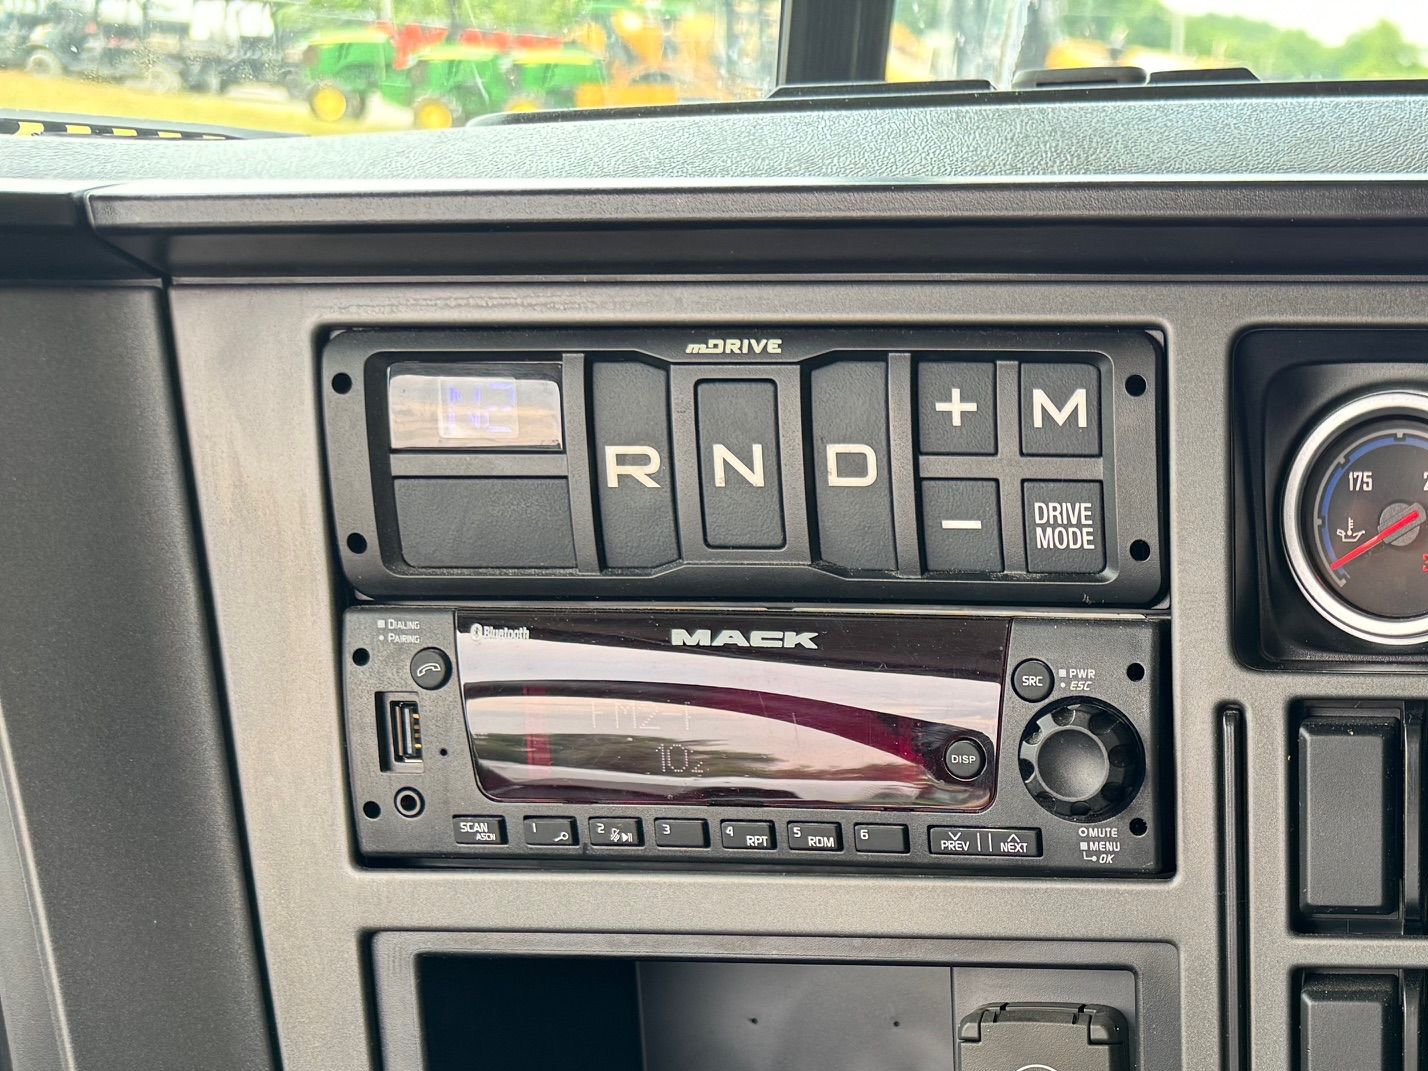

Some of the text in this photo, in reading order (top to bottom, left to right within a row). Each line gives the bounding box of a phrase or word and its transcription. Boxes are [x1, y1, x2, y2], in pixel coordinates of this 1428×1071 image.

[685, 339, 782, 354] mDRIVE
[1033, 389, 1086, 429] M
[606, 446, 660, 487] R
[715, 445, 764, 487] N
[826, 445, 876, 487] D
[1348, 472, 1373, 491] 175
[1034, 503, 1092, 525] DRIVE
[1036, 528, 1094, 550] MODE
[388, 620, 420, 630] DIALING
[388, 634, 420, 643] PAIRING
[483, 626, 530, 640] Bluetooth
[671, 628, 819, 648] MACK
[1069, 669, 1095, 678] PWR
[1022, 676, 1043, 687] SRC
[1070, 681, 1092, 690] ESC
[951, 755, 976, 764] DISP
[460, 822, 488, 832] SCAN
[532, 823, 536, 833] 1
[597, 823, 605, 834] 2
[663, 824, 671, 834] 3
[726, 827, 734, 836] 4
[1089, 828, 1119, 837] MUTE
[476, 833, 496, 841] ASCN
[793, 828, 801, 838] 5
[860, 830, 869, 840] 6
[746, 836, 768, 847] RPT
[808, 837, 835, 848] RDM
[941, 840, 970, 851] PREV
[1089, 842, 1121, 852] MENU
[1000, 842, 1028, 853] NEXT
[1099, 854, 1115, 863] OK
